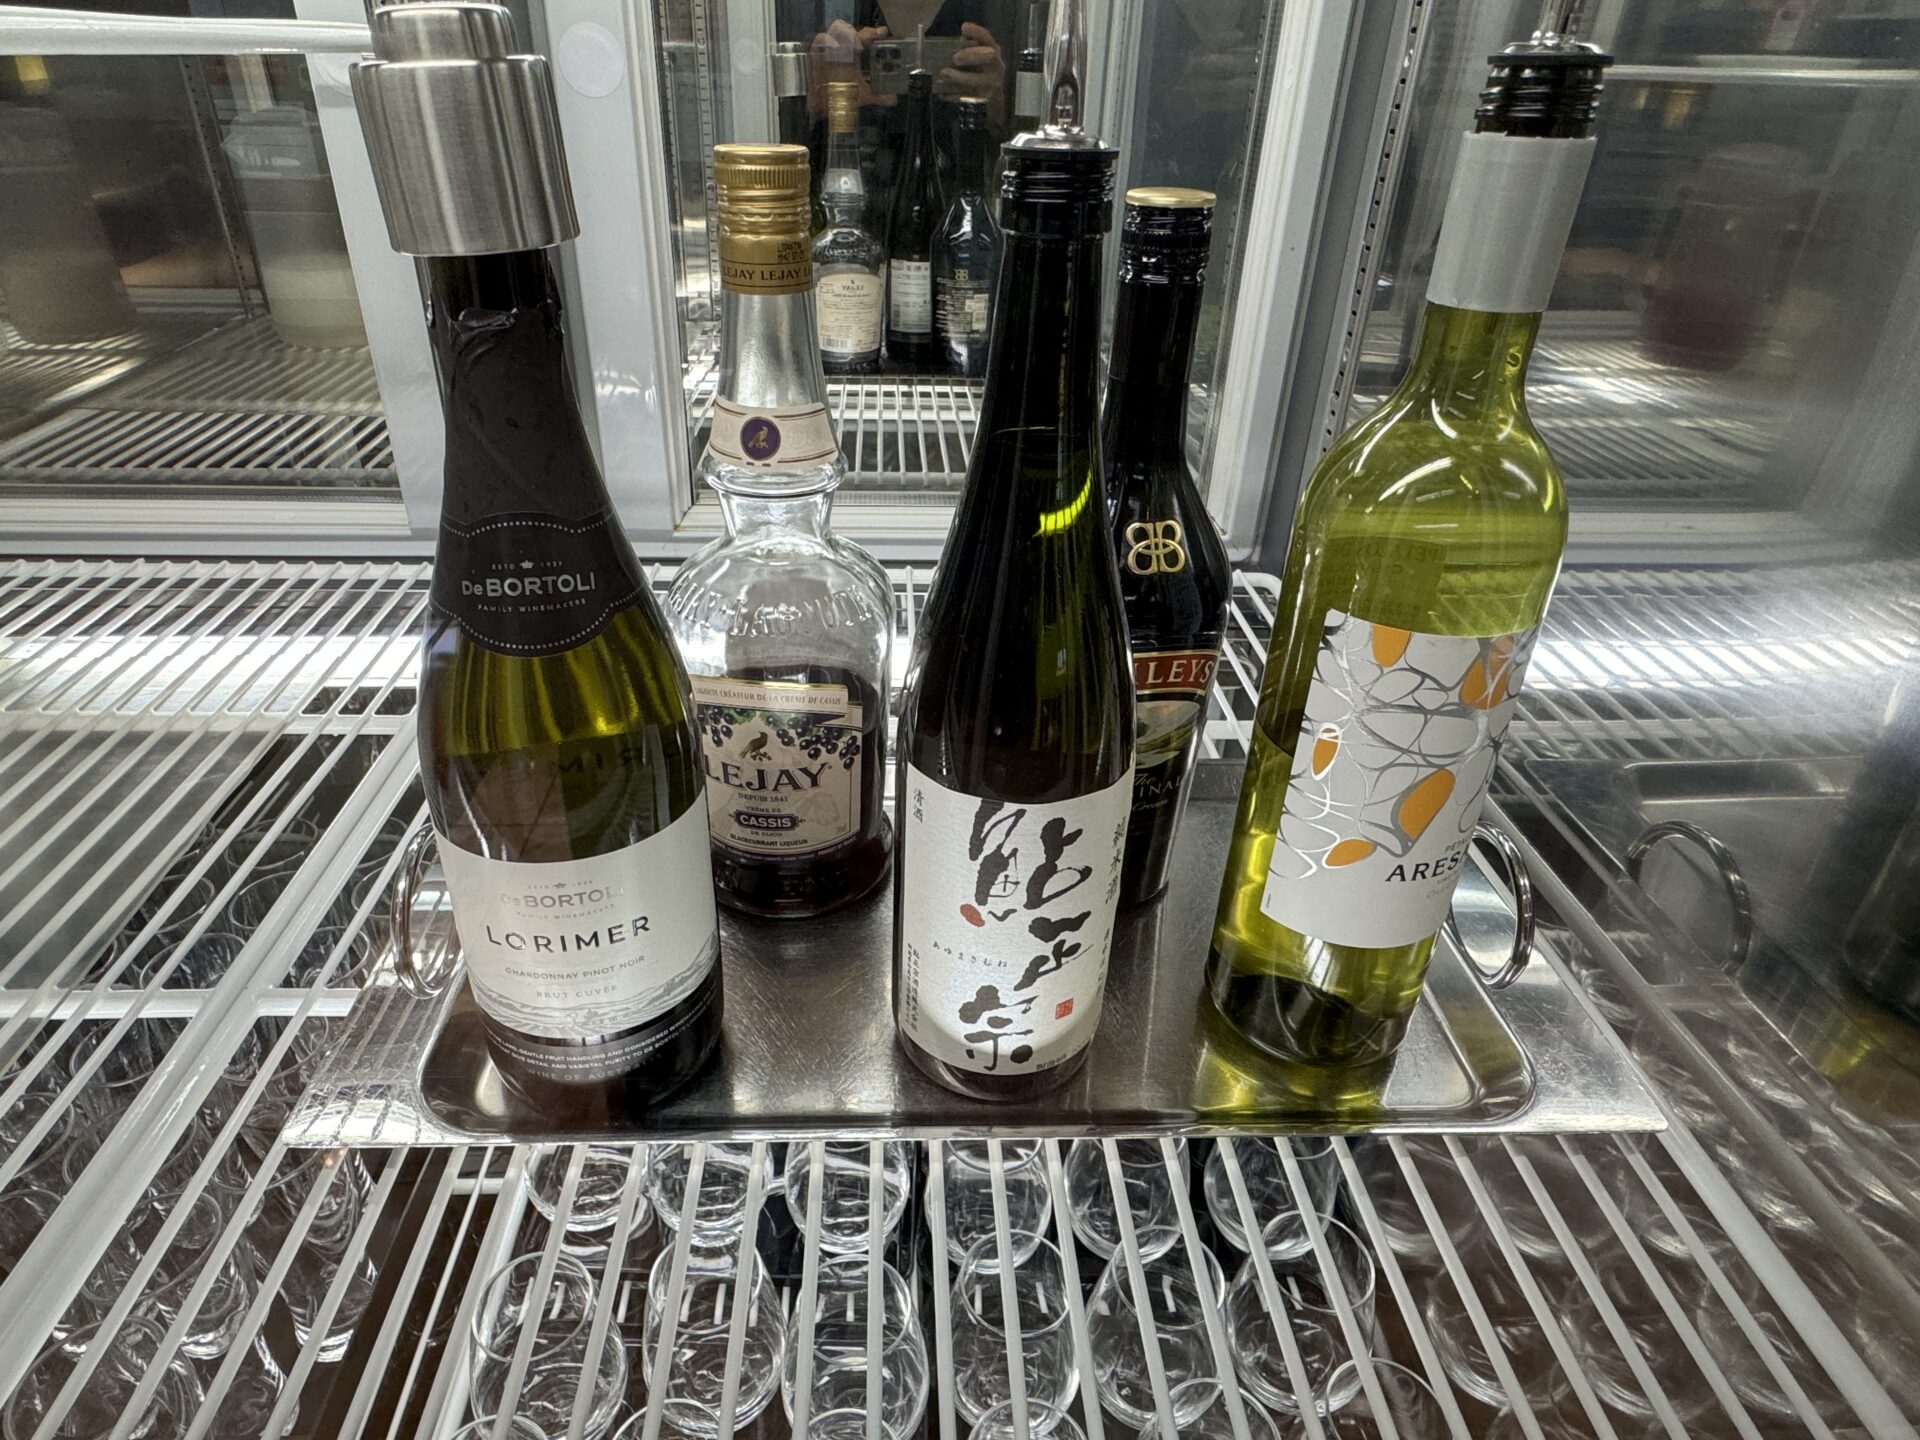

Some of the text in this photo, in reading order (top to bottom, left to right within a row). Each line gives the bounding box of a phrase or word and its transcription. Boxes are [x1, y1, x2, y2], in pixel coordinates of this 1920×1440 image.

[723, 265, 755, 280] LEJAY
[761, 267, 801, 281] LEJAY
[485, 571, 596, 597] BORTOLI
[477, 597, 587, 613] FAMILY WINEMAKERS
[1135, 658, 1215, 686] LEYS
[705, 754, 829, 793] LEJAY
[912, 787, 925, 824] 清酒
[740, 814, 792, 829] CASSIS
[729, 833, 778, 847] BLACKCURRANT
[779, 838, 808, 848] LIQUEUR
[485, 915, 652, 954] LORIMER
[932, 940, 1008, 968] あゆまさむね
[504, 954, 646, 980] CHARDONNAY PINOT NOIR
[536, 991, 569, 1000] BRUT
[545, 1054, 565, 1062] FRUIT
[566, 1053, 606, 1062] HANDLING
[607, 1048, 624, 1059] AND
[551, 1062, 567, 1070] AND
[568, 1061, 604, 1070] VARIETAL
[605, 1054, 632, 1066] PURITY
[632, 1050, 643, 1058] TO
